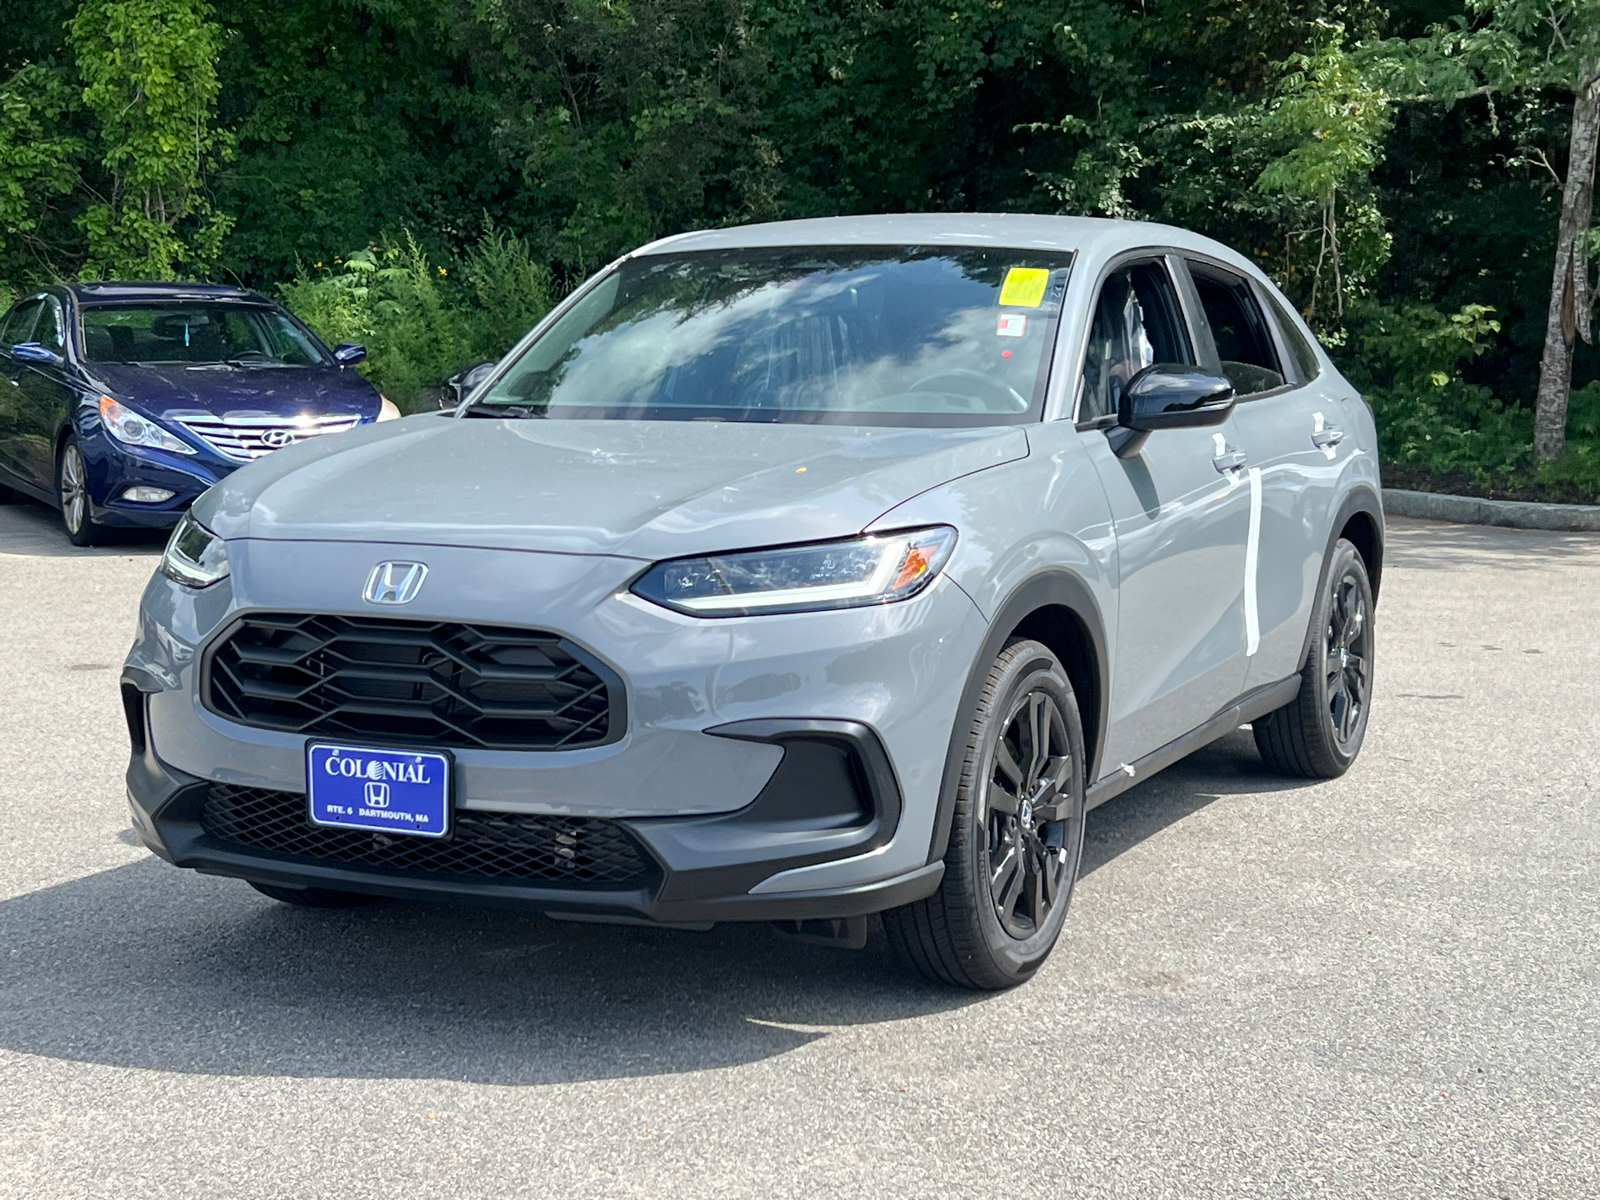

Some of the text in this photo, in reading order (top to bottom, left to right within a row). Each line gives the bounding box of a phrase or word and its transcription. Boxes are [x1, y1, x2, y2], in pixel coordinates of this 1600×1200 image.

[325, 756, 430, 784] COLONIAL
[347, 807, 353, 815] 6
[358, 808, 414, 822] DARTMOUTH,
[415, 814, 429, 823] MA
